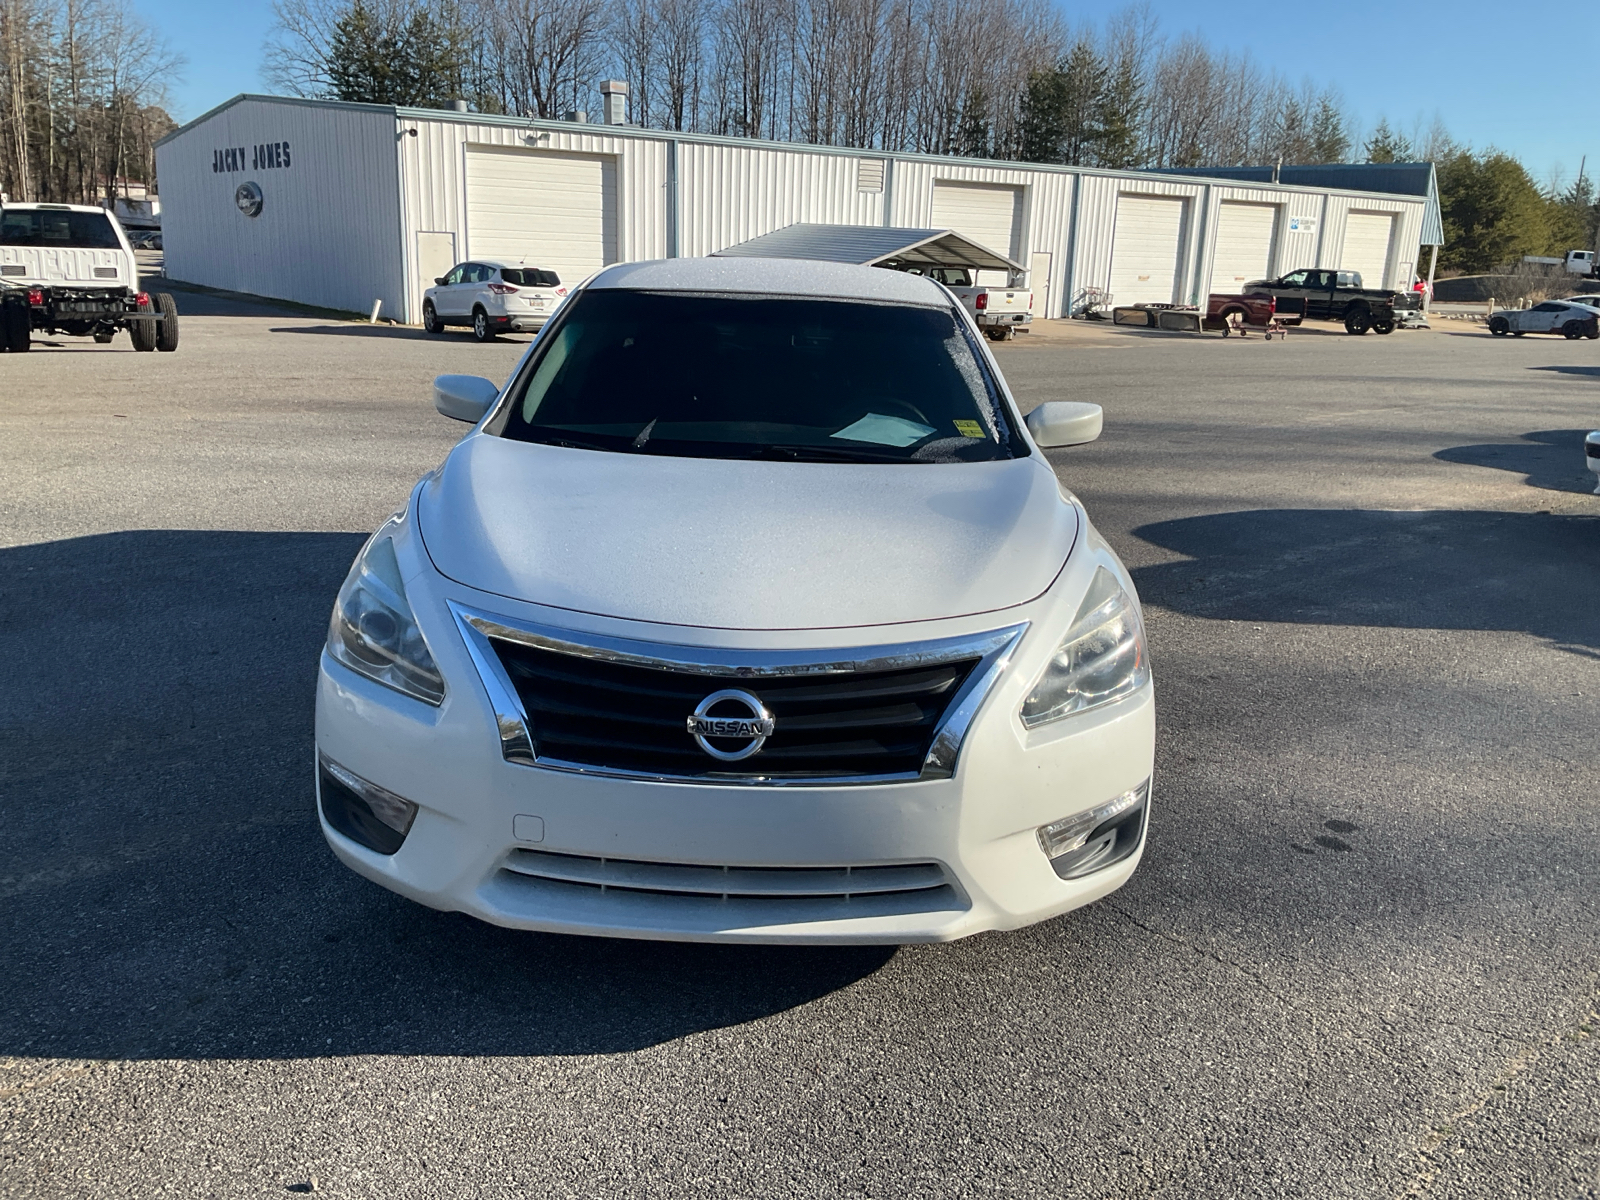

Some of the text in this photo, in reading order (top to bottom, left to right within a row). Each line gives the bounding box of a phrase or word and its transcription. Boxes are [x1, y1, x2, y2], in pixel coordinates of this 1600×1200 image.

[212, 141, 291, 173] JACKY JONES
[696, 720, 764, 733] NISSAN
